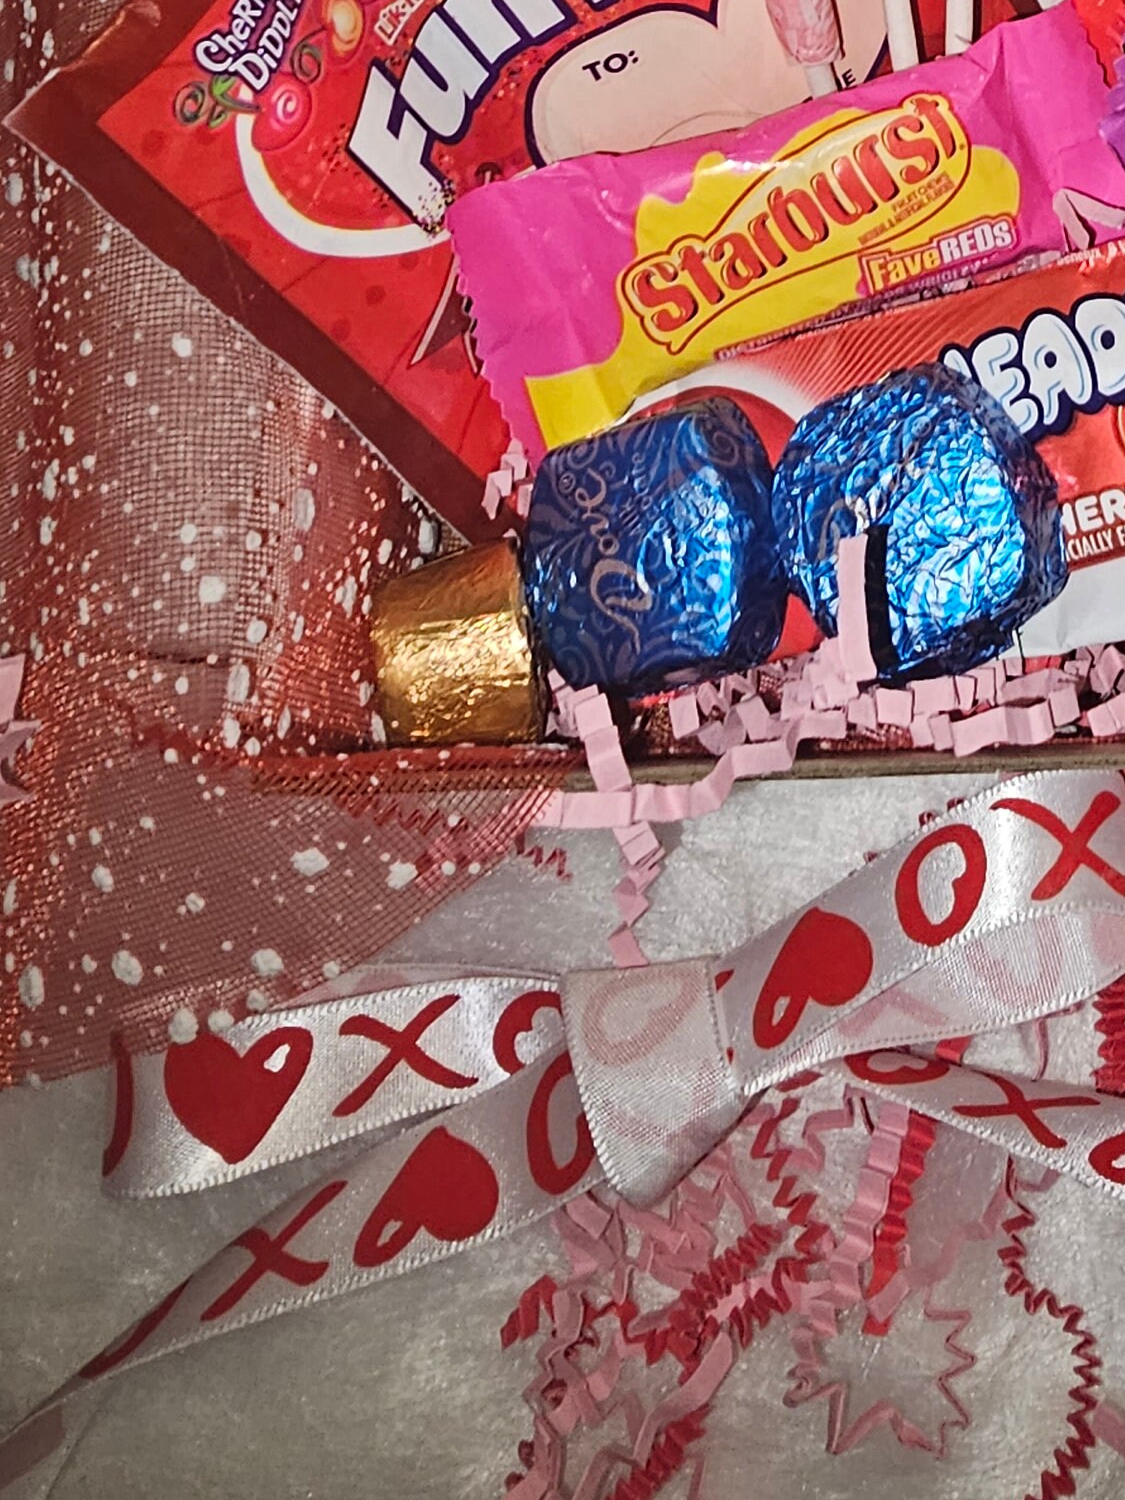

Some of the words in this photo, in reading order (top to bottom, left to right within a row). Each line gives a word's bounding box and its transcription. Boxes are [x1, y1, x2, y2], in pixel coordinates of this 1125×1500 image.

[582, 49, 640, 82] TO:
[632, 97, 958, 333] Starburst
[868, 221, 1013, 291] FaveREDs
[574, 467, 653, 655] Dove
